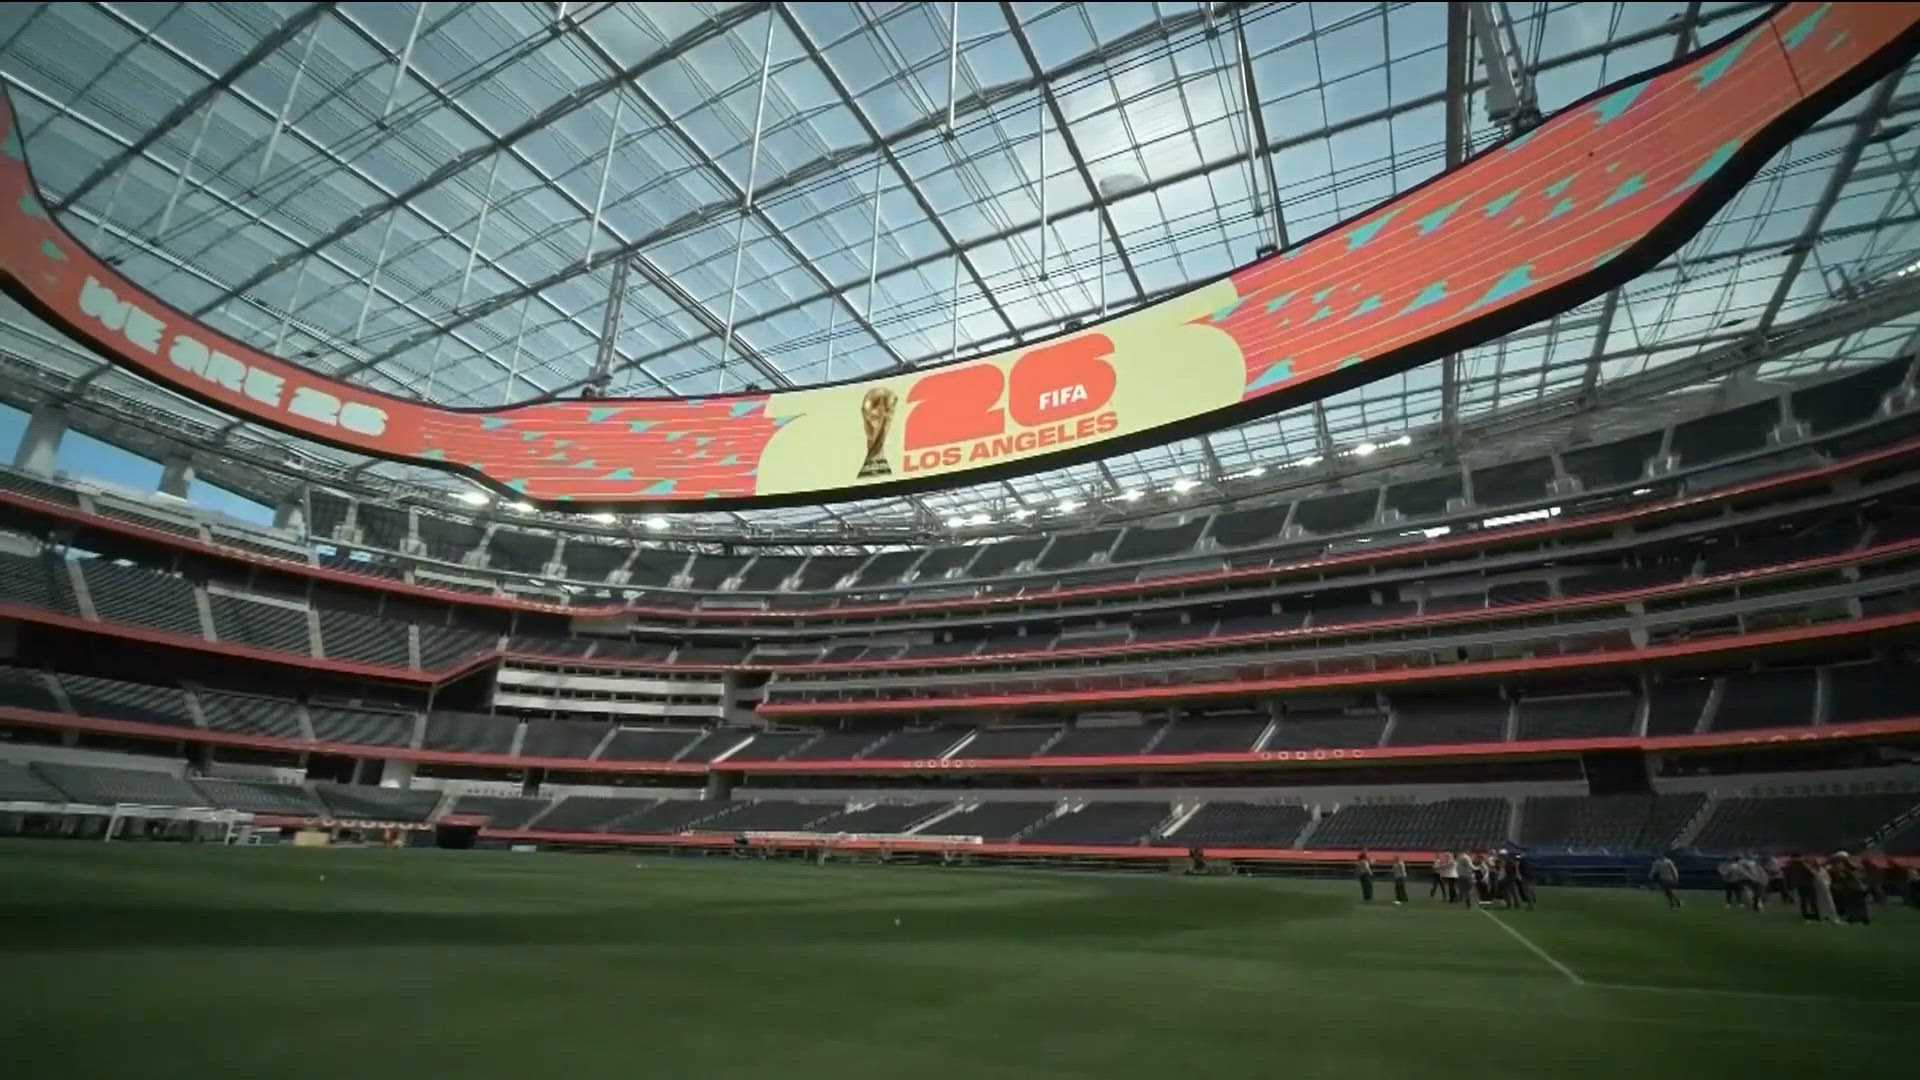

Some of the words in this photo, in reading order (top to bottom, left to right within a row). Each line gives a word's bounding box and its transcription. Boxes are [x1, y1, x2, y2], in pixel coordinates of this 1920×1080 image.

[904, 333, 1117, 450] 26
[1038, 383, 1088, 411] FIFA
[902, 446, 962, 473] LOS
[968, 411, 1119, 463] ANGELES
